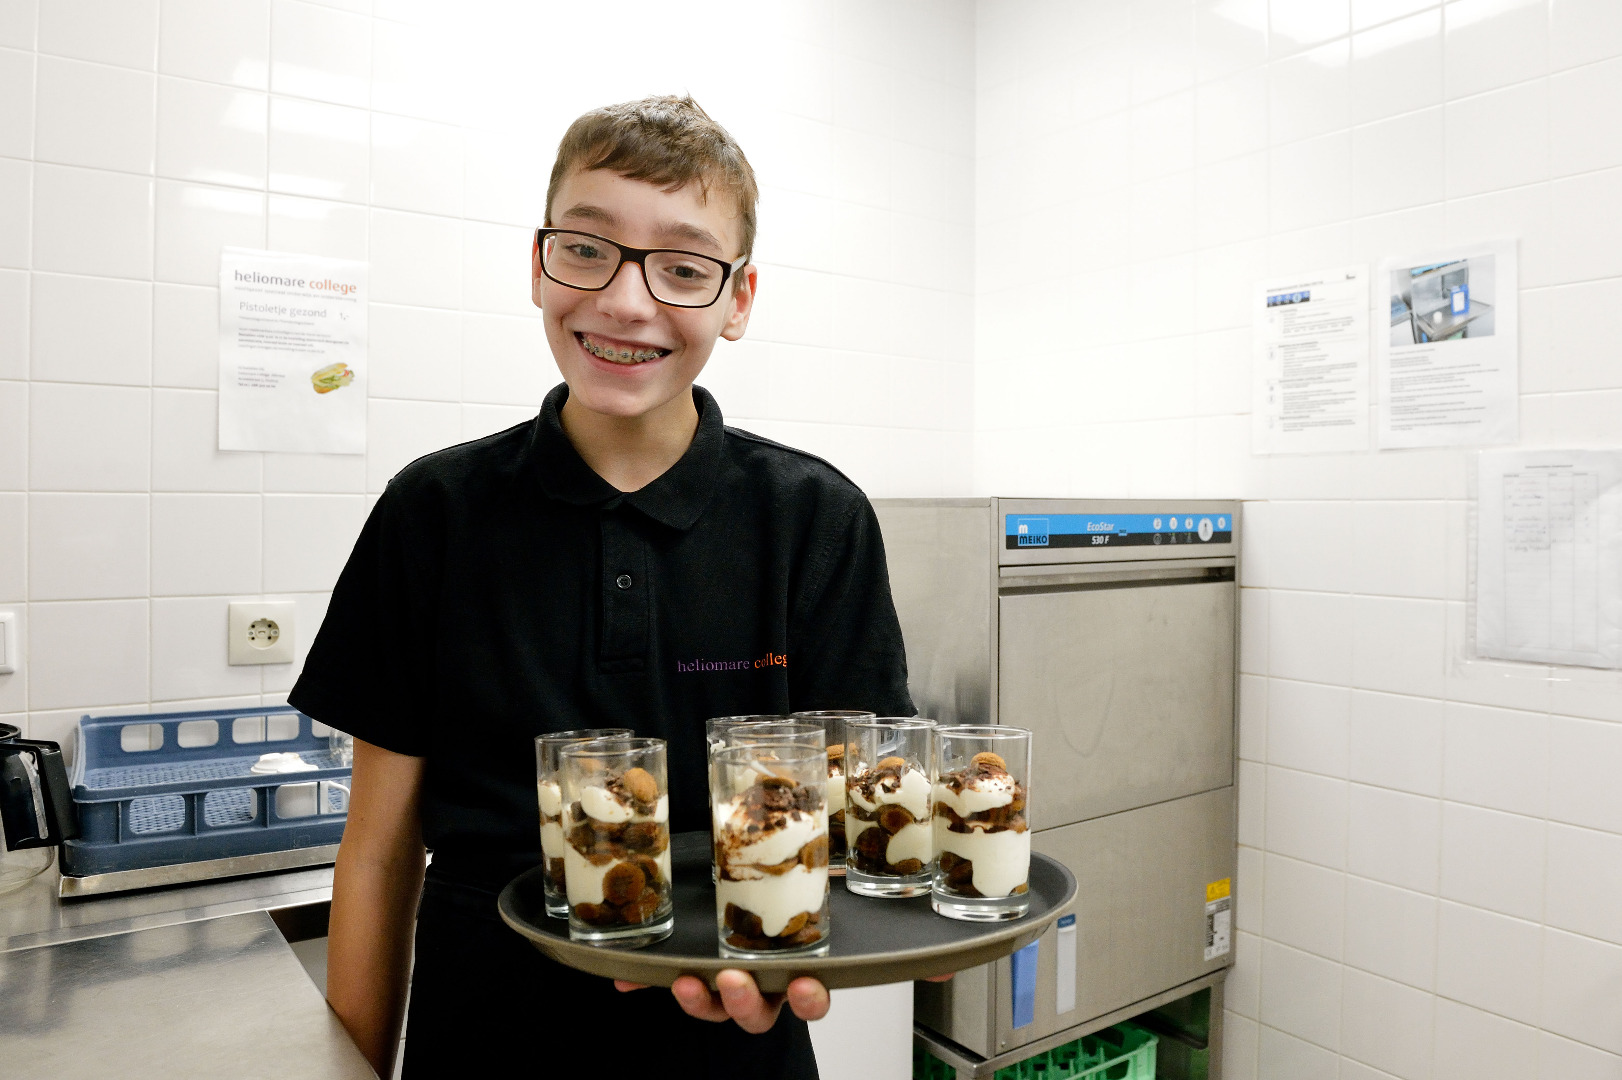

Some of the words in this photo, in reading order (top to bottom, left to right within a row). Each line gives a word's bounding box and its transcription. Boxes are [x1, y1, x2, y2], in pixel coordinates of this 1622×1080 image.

[234, 269, 305, 288] heliomare
[309, 280, 357, 295] college
[239, 301, 287, 316] Pistoletje
[289, 307, 327, 318] gezond
[1087, 521, 1114, 531] EcoStar
[1091, 535, 1104, 545] 530
[1104, 535, 1110, 545] F
[677, 658, 750, 673] heliomare
[754, 652, 787, 669] colleg
